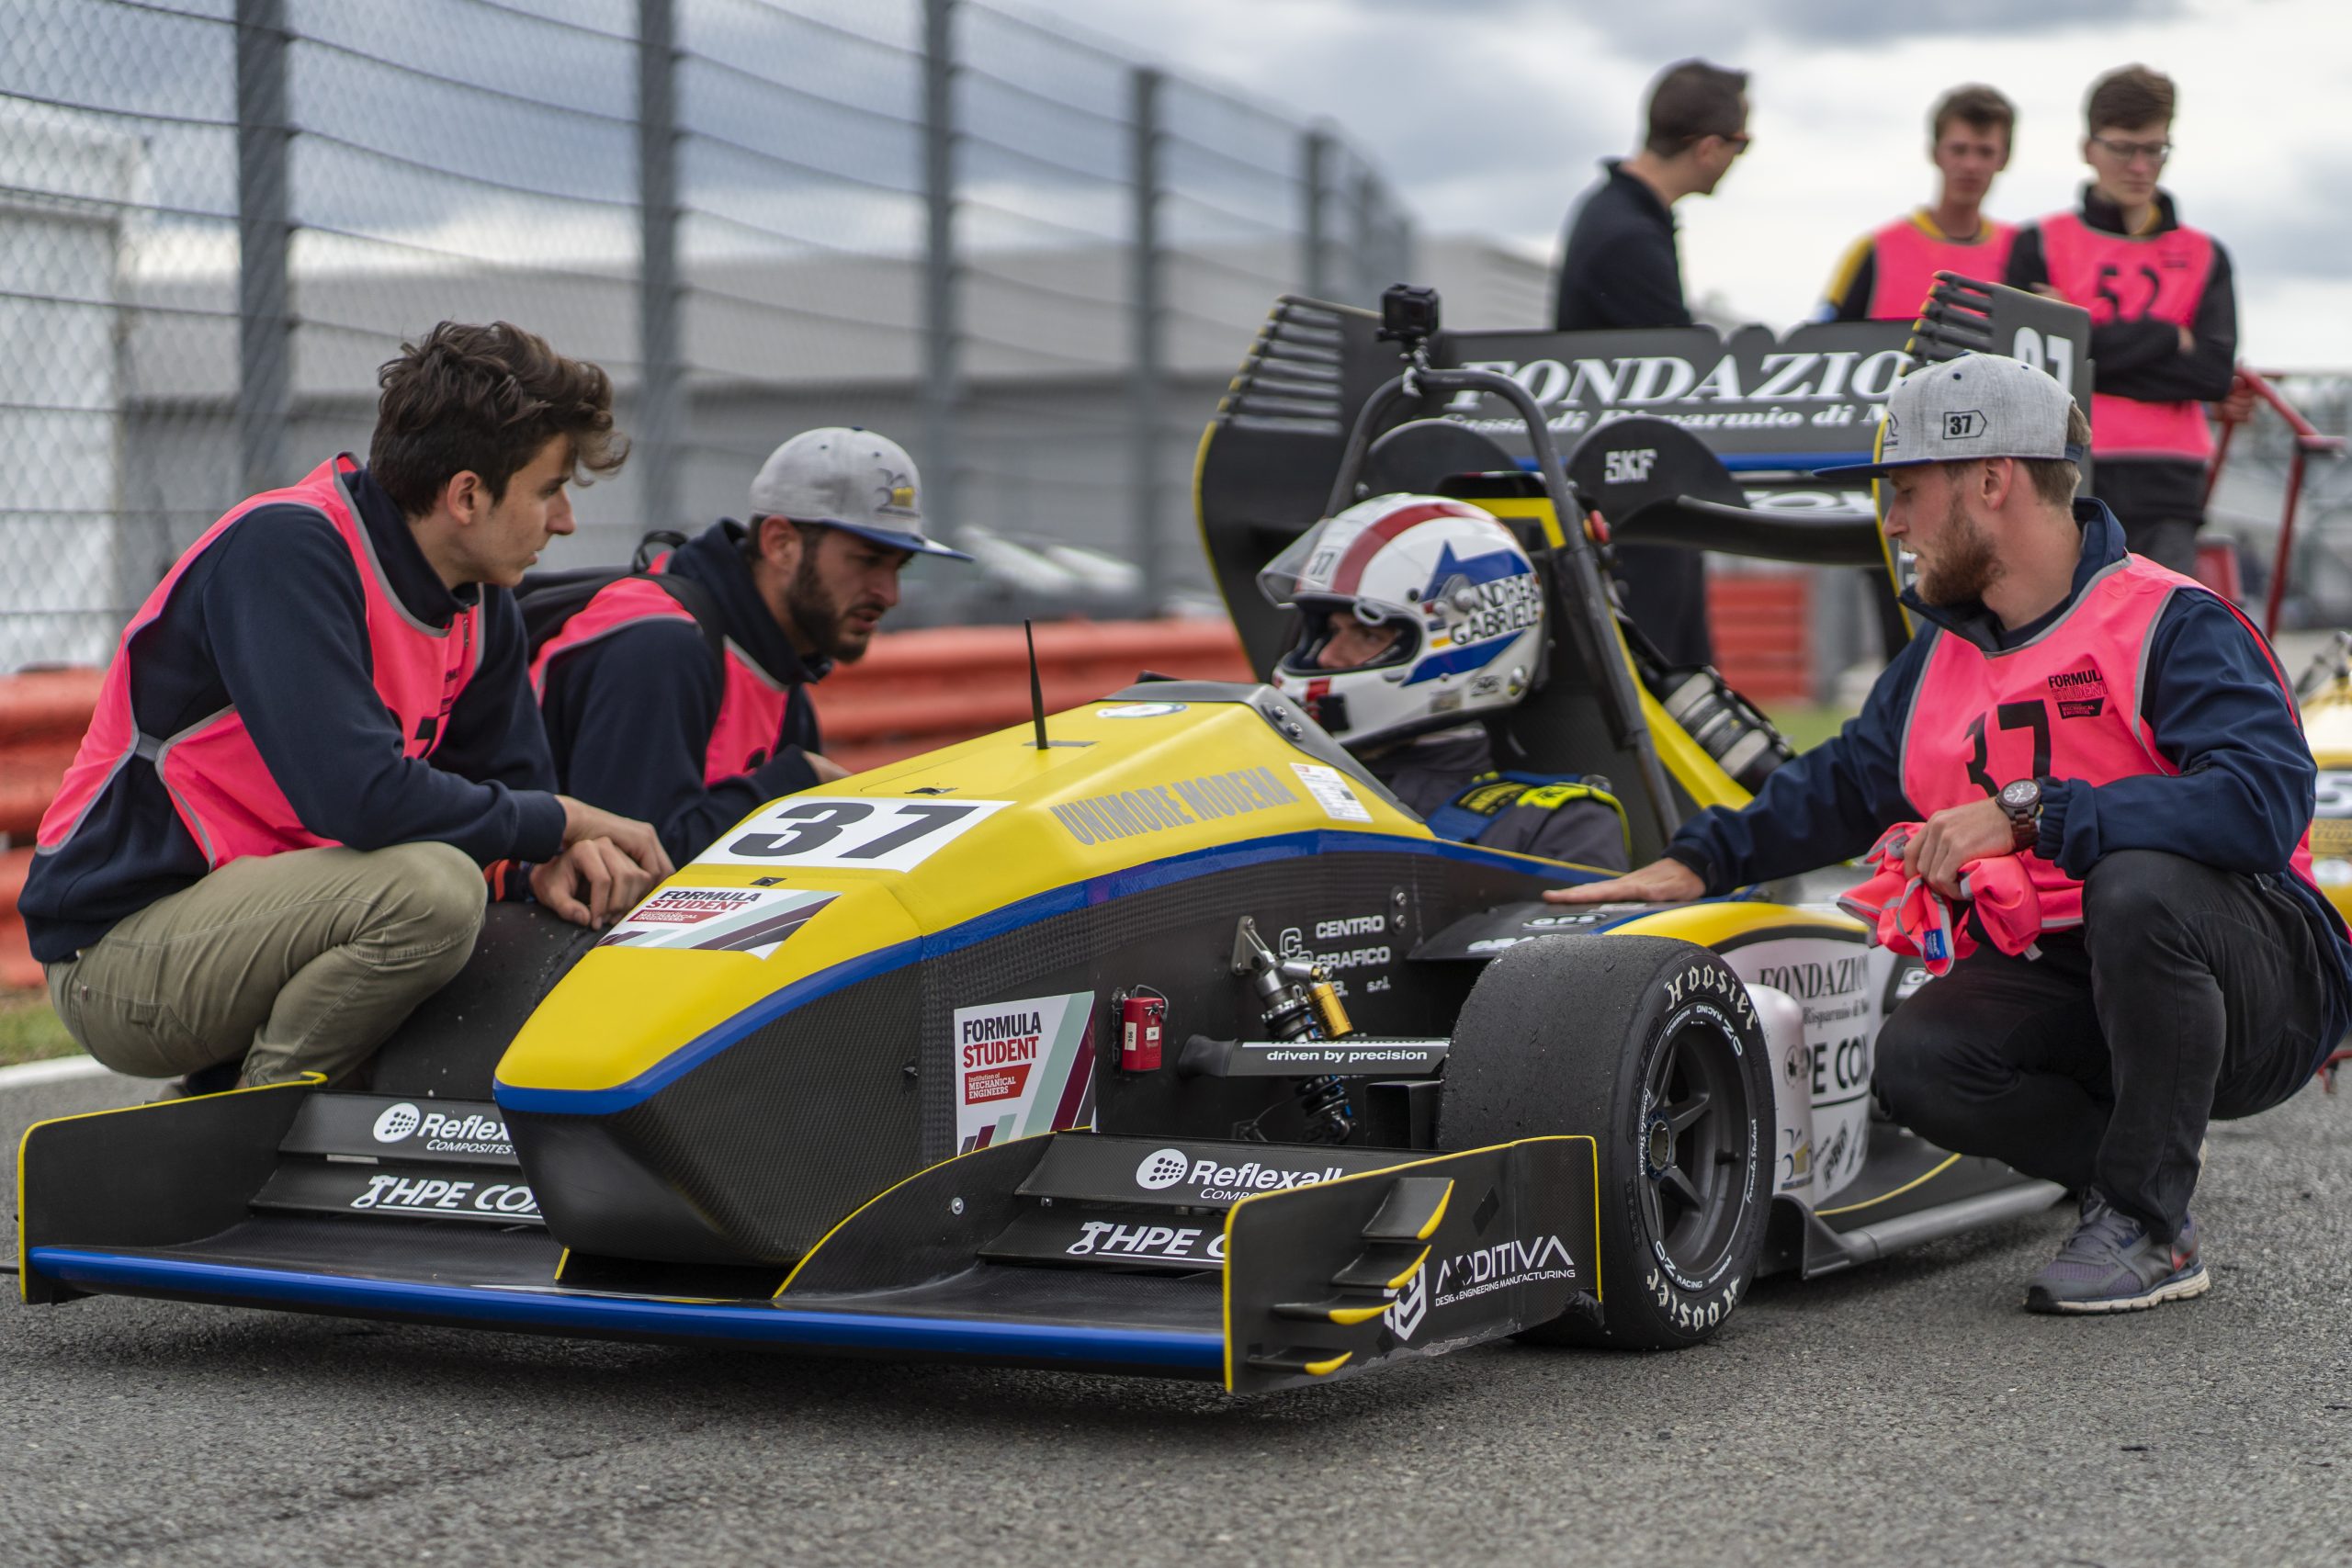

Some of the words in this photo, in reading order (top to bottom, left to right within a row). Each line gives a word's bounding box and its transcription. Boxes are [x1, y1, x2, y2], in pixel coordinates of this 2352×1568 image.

[1547, 410, 1590, 434] di
[1811, 404, 1857, 427] di
[1950, 414, 1973, 436] 37
[1605, 448, 1657, 484] SKF
[1048, 784, 1196, 846] UNIMORE
[1170, 765, 1300, 821] MODENA
[729, 801, 981, 860] 37
[645, 899, 750, 911] STUDENT
[658, 890, 763, 903] FORMULA
[1316, 914, 1385, 940] CENTRO
[1317, 945, 1392, 970] GRAFICO
[963, 1011, 1042, 1043] FORMULA
[963, 1036, 1040, 1068] STUDENT
[1266, 1050, 1320, 1061] driven
[1323, 1050, 1340, 1064] by
[1348, 1050, 1428, 1064] precision
[967, 1073, 994, 1083] Institution
[968, 1076, 1017, 1091] MECHANICAL
[968, 1086, 1009, 1100] ENGINEERS
[1187, 1159, 1354, 1191] Reflexall
[1200, 1188, 1262, 1201] COMP
[1435, 1293, 1459, 1307] DESIG
[1459, 1280, 1499, 1300] ENGINEERING
[1499, 1269, 1577, 1289] MANUFACTURING
[1677, 1274, 1703, 1289] RACING
